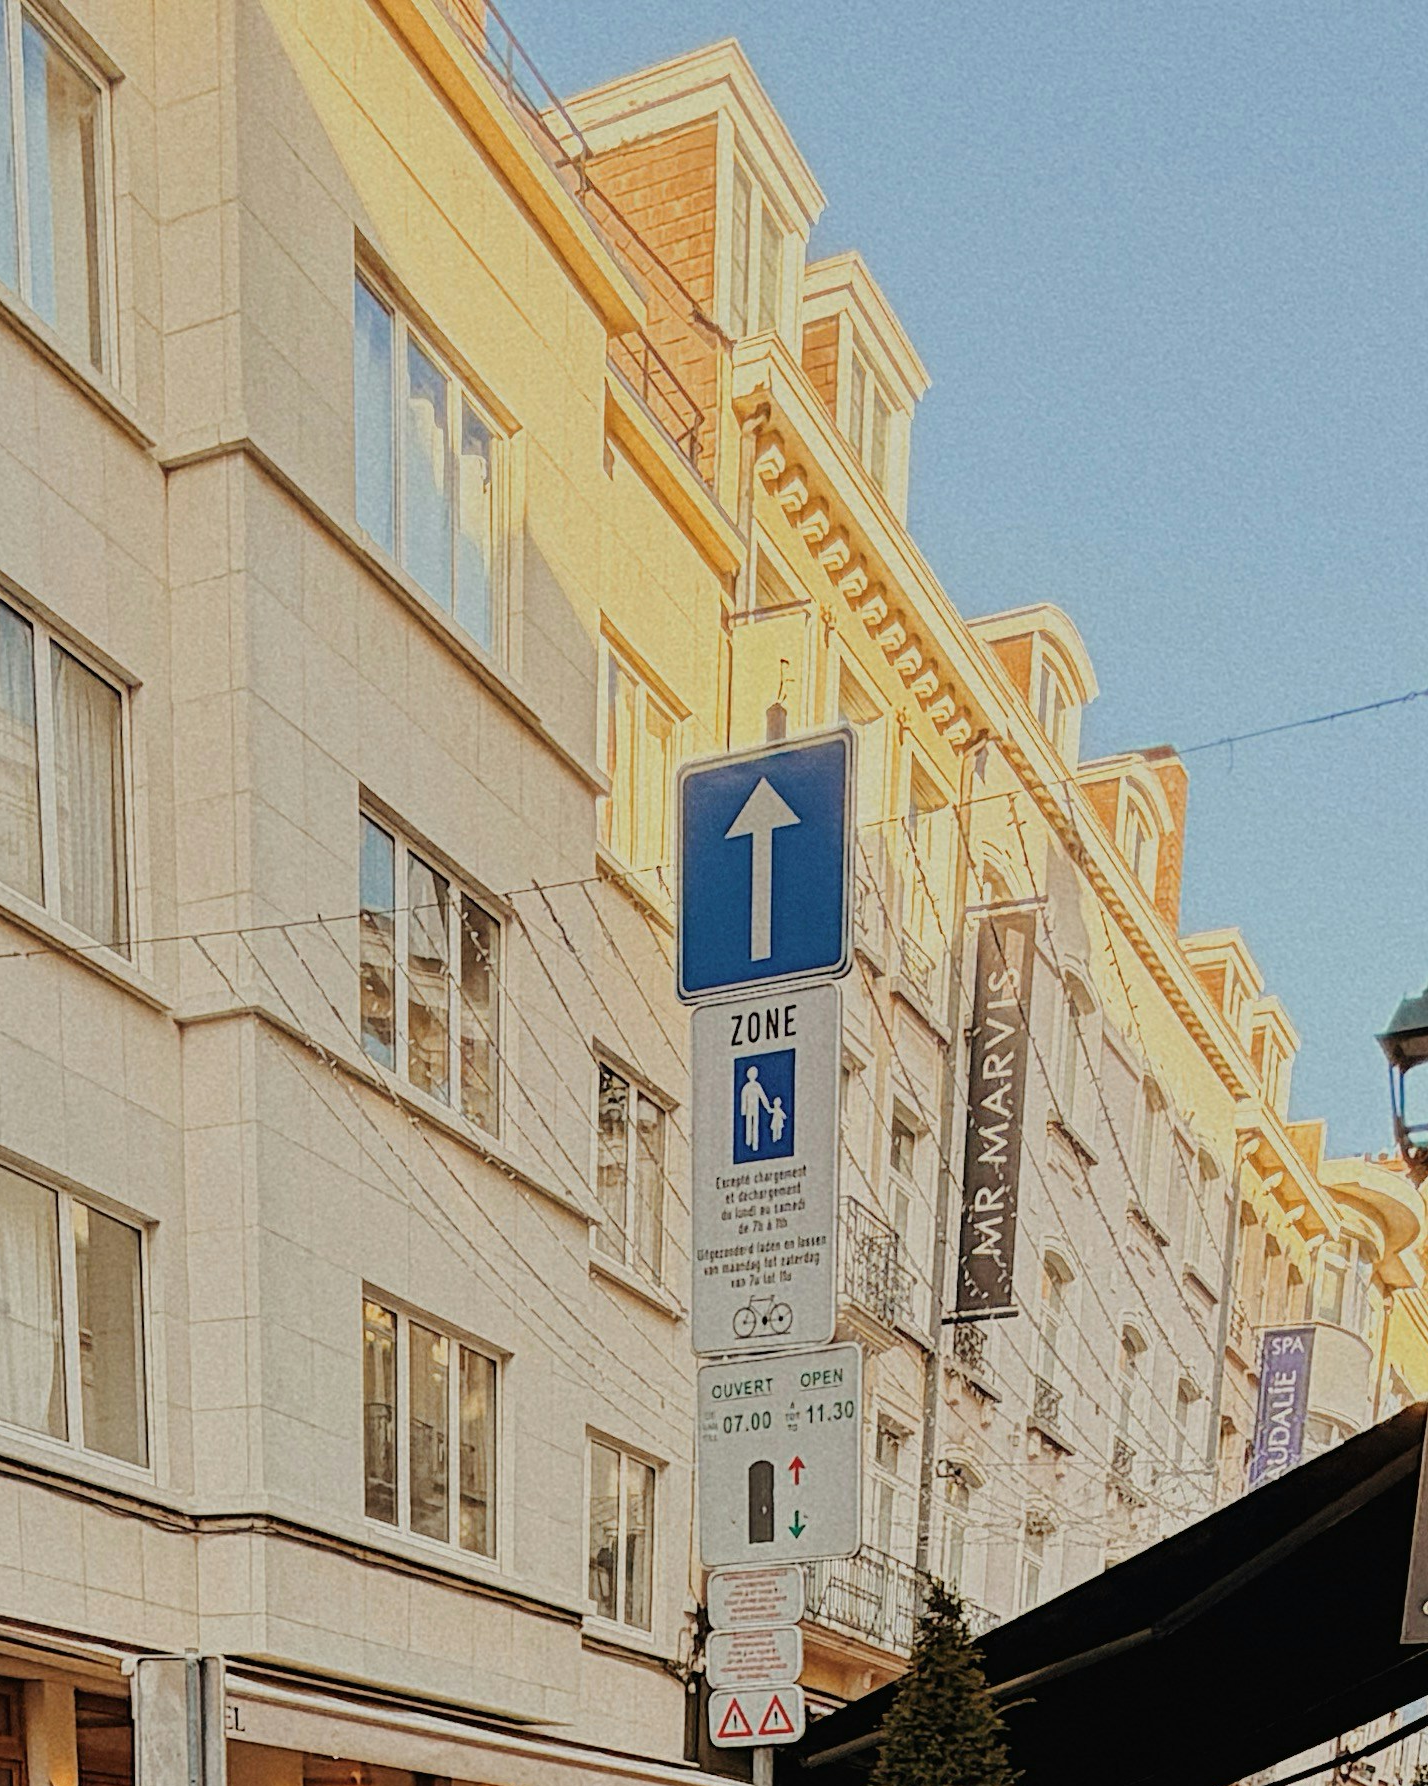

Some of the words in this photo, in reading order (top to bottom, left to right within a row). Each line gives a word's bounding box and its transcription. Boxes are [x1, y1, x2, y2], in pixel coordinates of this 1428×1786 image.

[730, 1004, 798, 1046] ZONE
[978, 968, 1022, 1163] MARVIS
[972, 1184, 1006, 1255] MR
[1272, 1335, 1305, 1355] SPA
[712, 1378, 774, 1399] OUVERT
[800, 1368, 844, 1388] OPEN
[723, 1410, 772, 1434] 07.00
[806, 1400, 854, 1424] 11.30
